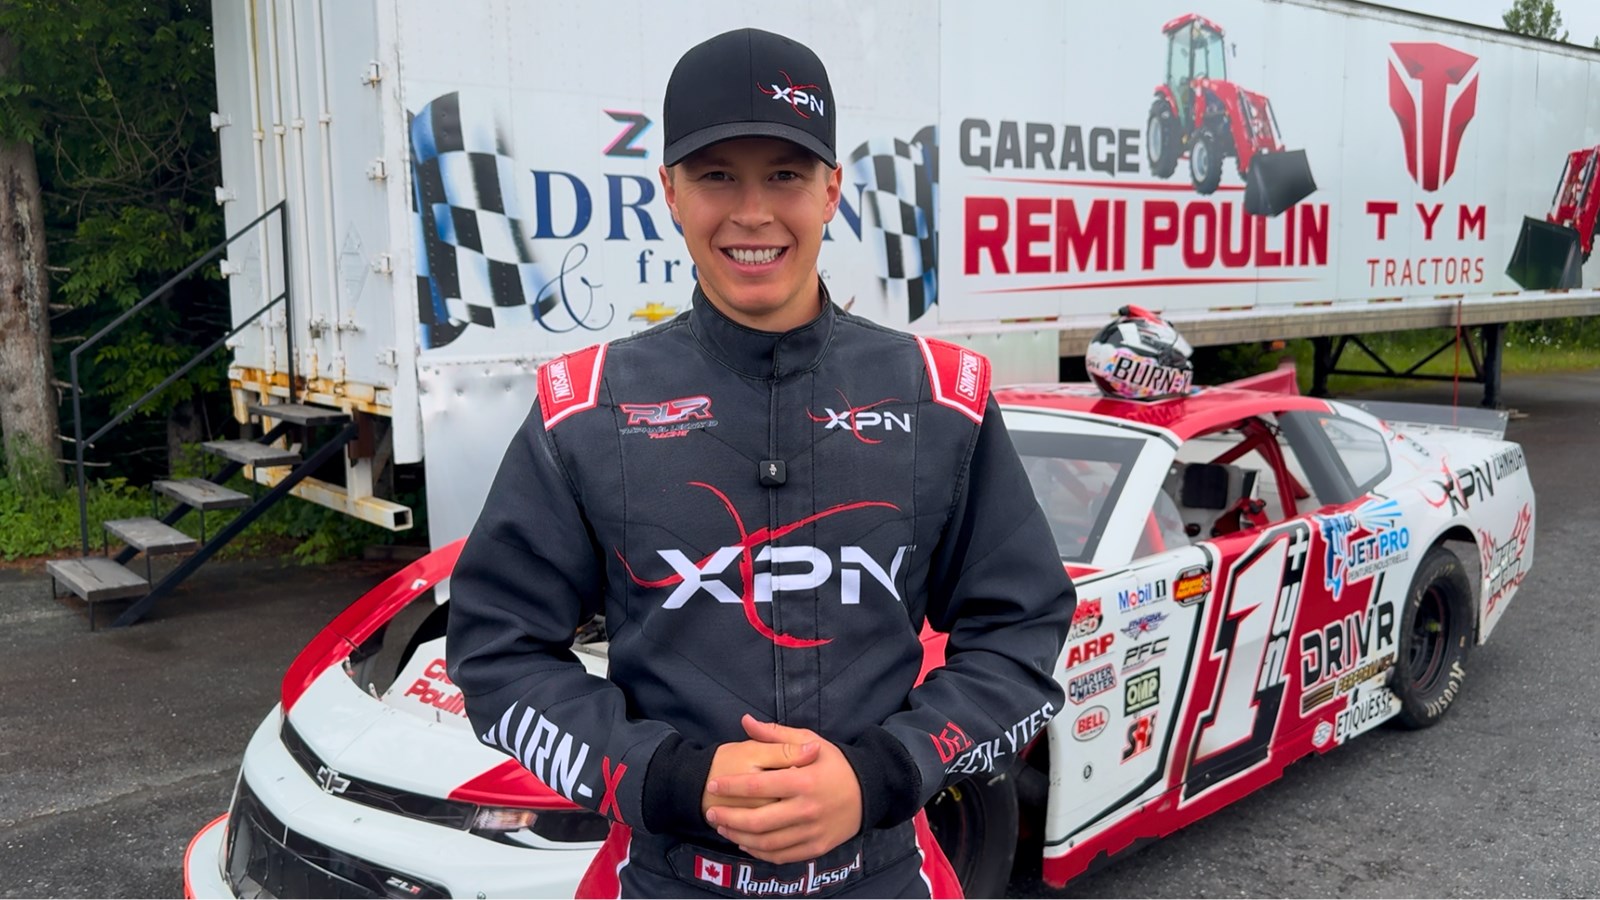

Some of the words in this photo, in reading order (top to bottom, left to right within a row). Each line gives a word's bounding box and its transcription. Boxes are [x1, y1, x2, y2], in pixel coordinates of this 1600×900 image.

[771, 84, 824, 117] XPN
[960, 118, 1140, 177] GARAGE
[964, 196, 1127, 275] REMI
[1142, 200, 1329, 270] POULIN
[1366, 201, 1486, 240] TYM
[1367, 257, 1484, 287] TRACTORS
[550, 360, 571, 398] SIMPSON
[959, 352, 979, 397] SIMPSON
[619, 394, 714, 425] RLR
[824, 407, 912, 433] XPN
[1432, 459, 1494, 516] XPN
[656, 545, 907, 609] XPN
[1118, 584, 1152, 610] Mobil
[1155, 579, 1167, 598] 1
[1066, 632, 1115, 670] ARP
[1123, 636, 1170, 666] PFC
[1070, 666, 1112, 697] QUARTER
[1077, 677, 1114, 701] MASTER
[1126, 679, 1159, 702] OMP
[404, 678, 467, 718] Pouli
[1077, 711, 1105, 734] BELL
[737, 864, 805, 894] Raphael
